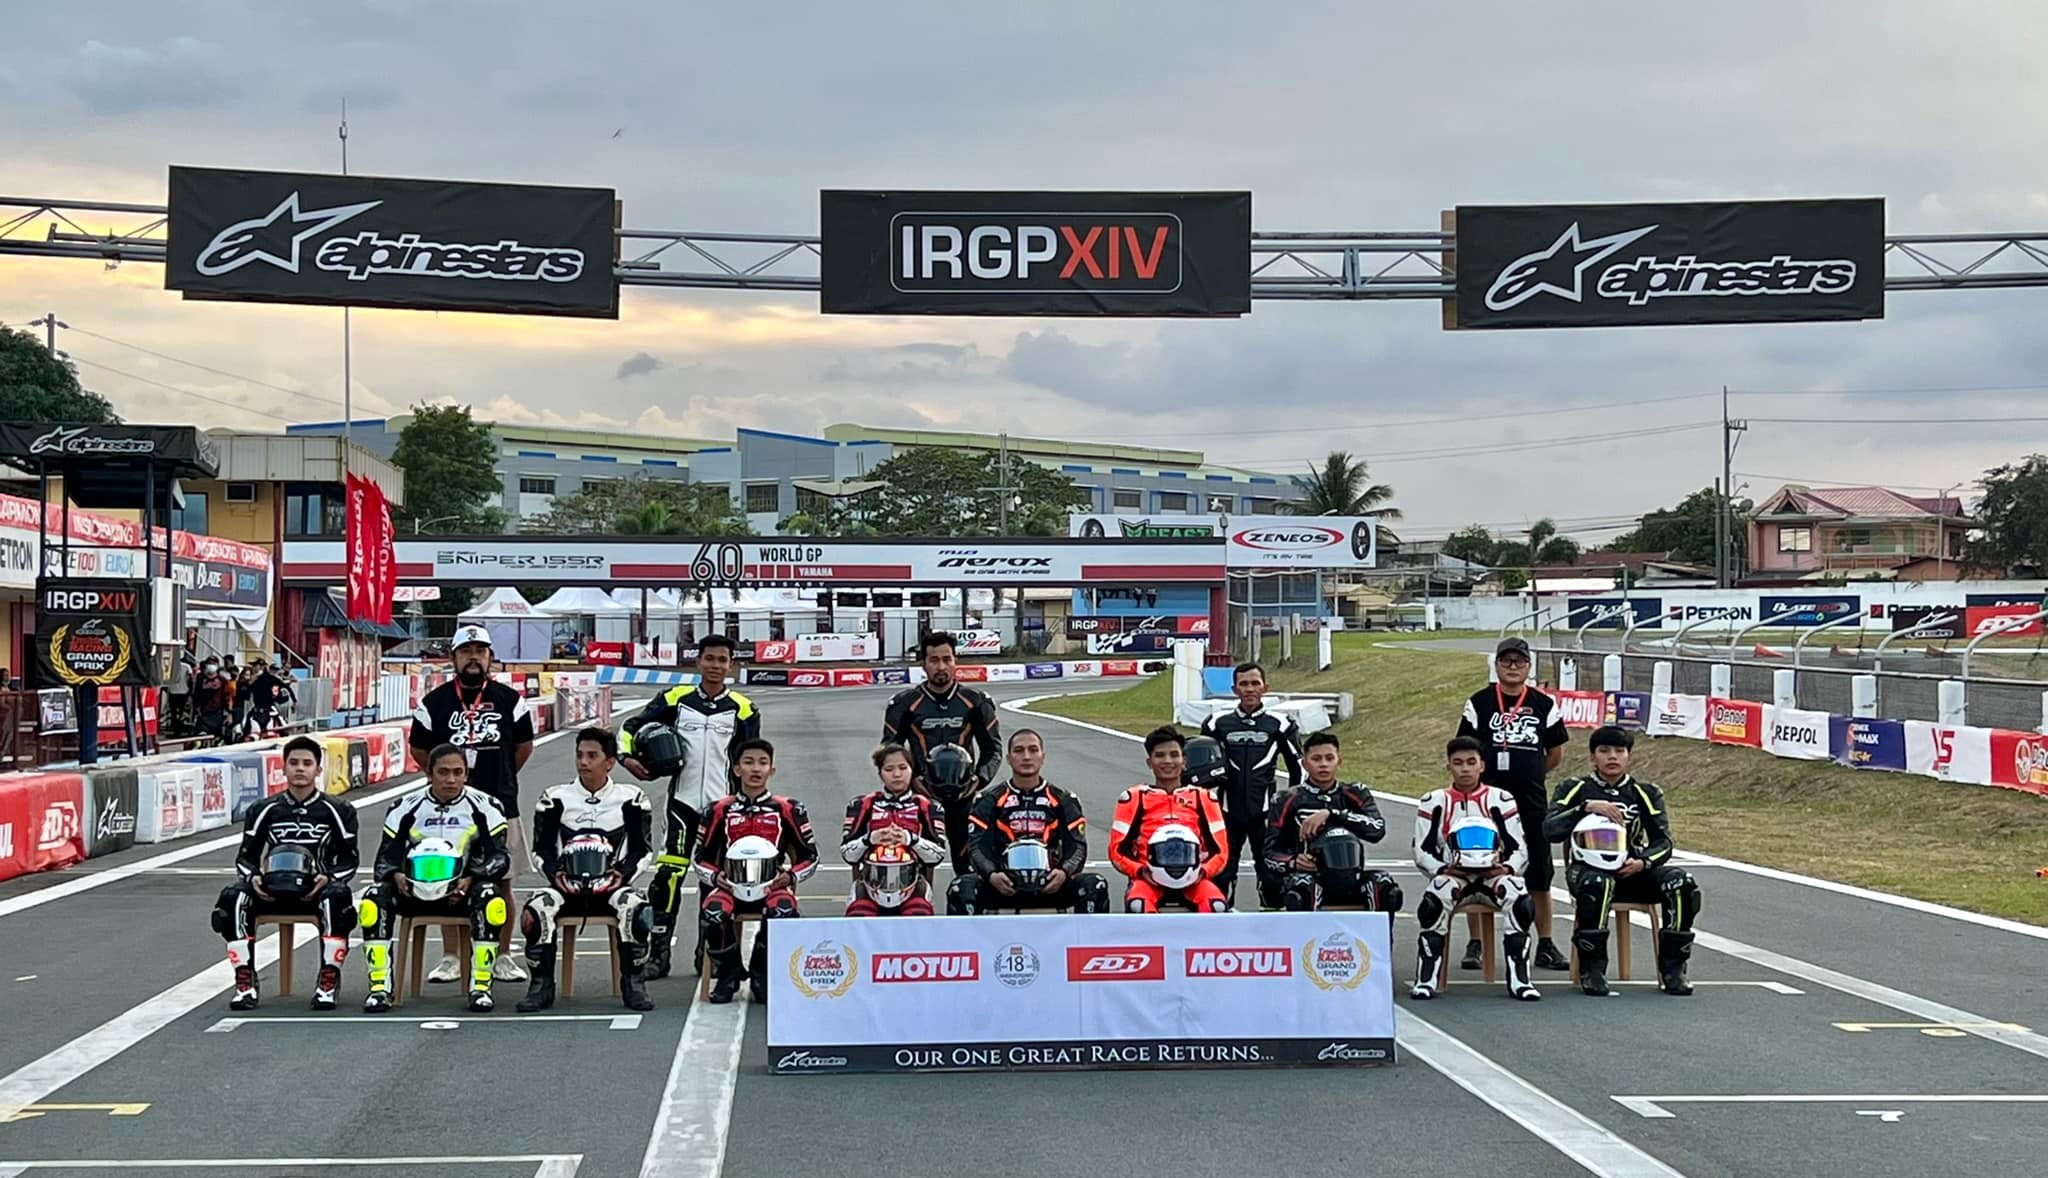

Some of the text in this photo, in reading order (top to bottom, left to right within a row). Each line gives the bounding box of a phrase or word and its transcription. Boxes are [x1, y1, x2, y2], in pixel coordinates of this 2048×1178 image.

[315, 231, 585, 283] alpinestars
[902, 224, 1169, 280] IRGPXIV
[1597, 255, 1857, 306] alpinestars
[1247, 532, 1330, 544] ZENEOS
[437, 554, 535, 565] SNIPER
[691, 544, 743, 582] 60
[760, 547, 823, 562] WORLD GP
[799, 567, 833, 577] YAMAHA
[47, 591, 136, 611] IRGPXIV
[1686, 606, 1752, 621] PETRON
[66, 652, 114, 662] GRAND
[74, 662, 105, 670] PRIX
[1561, 697, 1599, 723] MOTUL
[1773, 724, 1818, 744] REPSOL
[875, 956, 975, 980] MOTUL
[1006, 955, 1024, 972] 18
[1080, 953, 1151, 975] FDR
[1189, 950, 1288, 974] MOTUL
[1316, 962, 1357, 970] GRAND
[803, 970, 844, 978] GRAND
[895, 1049, 945, 1067] OUR
[951, 1048, 1001, 1066] ONE
[1008, 1046, 1085, 1064] GREAT
[1091, 1045, 1150, 1062] RACE
